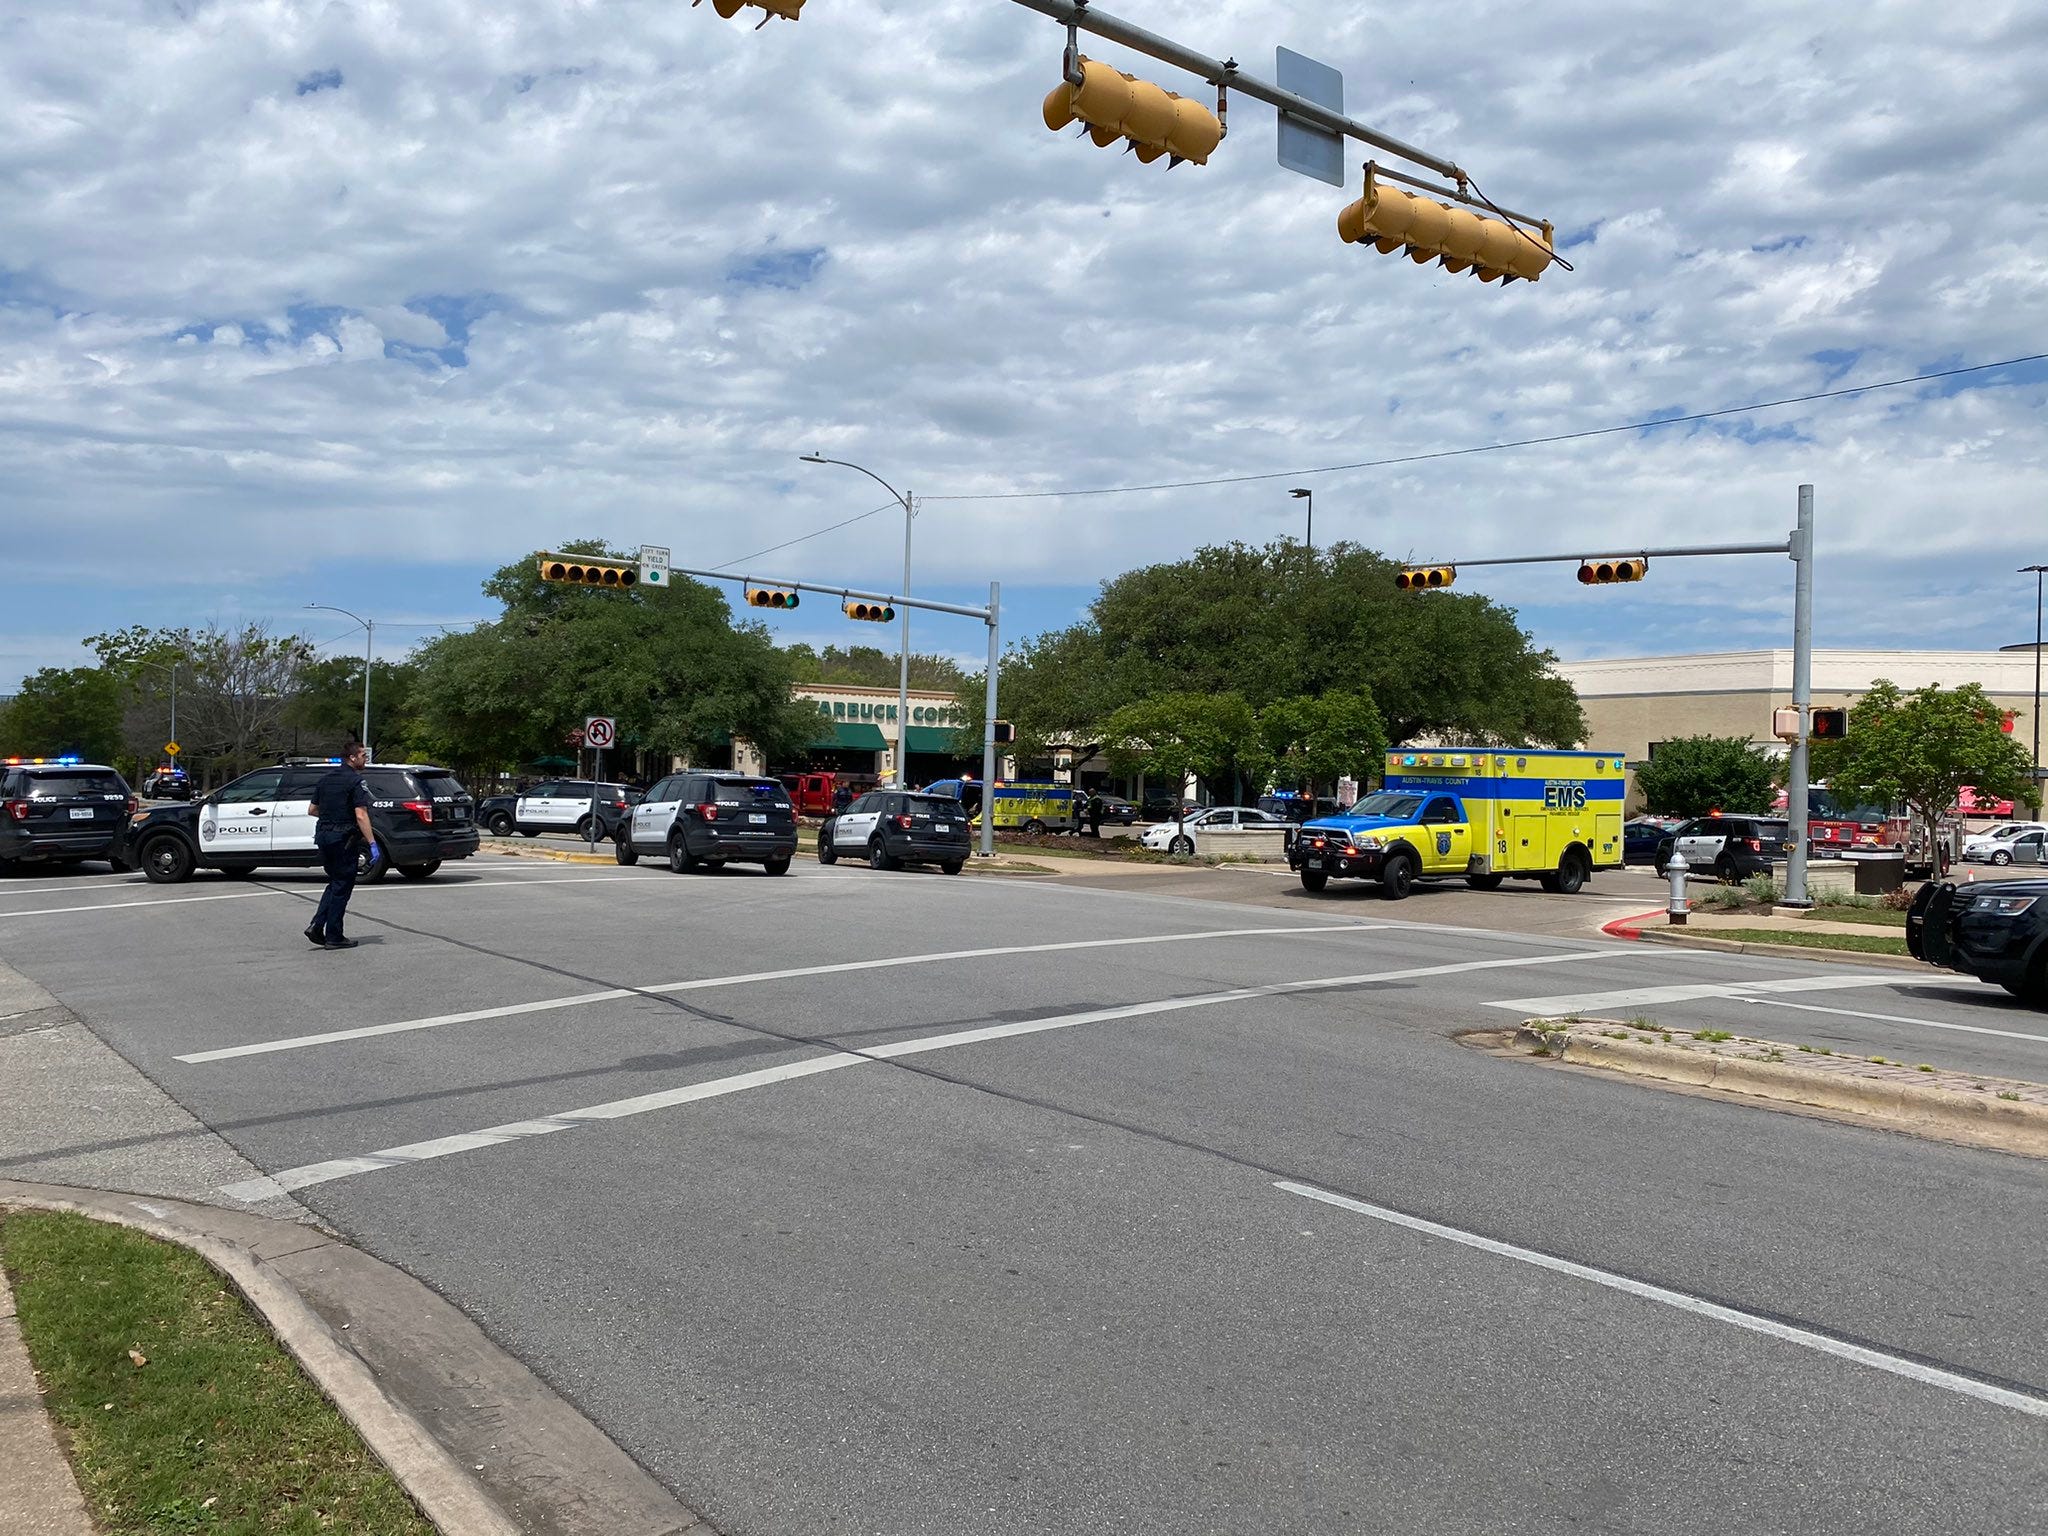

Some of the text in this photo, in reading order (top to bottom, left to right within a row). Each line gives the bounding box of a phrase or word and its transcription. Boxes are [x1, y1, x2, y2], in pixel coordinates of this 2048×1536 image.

[647, 555, 663, 563] YIELD
[1402, 777, 1443, 785] AUSTIN-TRAVIS
[1545, 787, 1585, 808] EMS
[1009, 799, 1014, 808] 6
[1825, 828, 1832, 839] 3
[1498, 840, 1506, 853] 18
